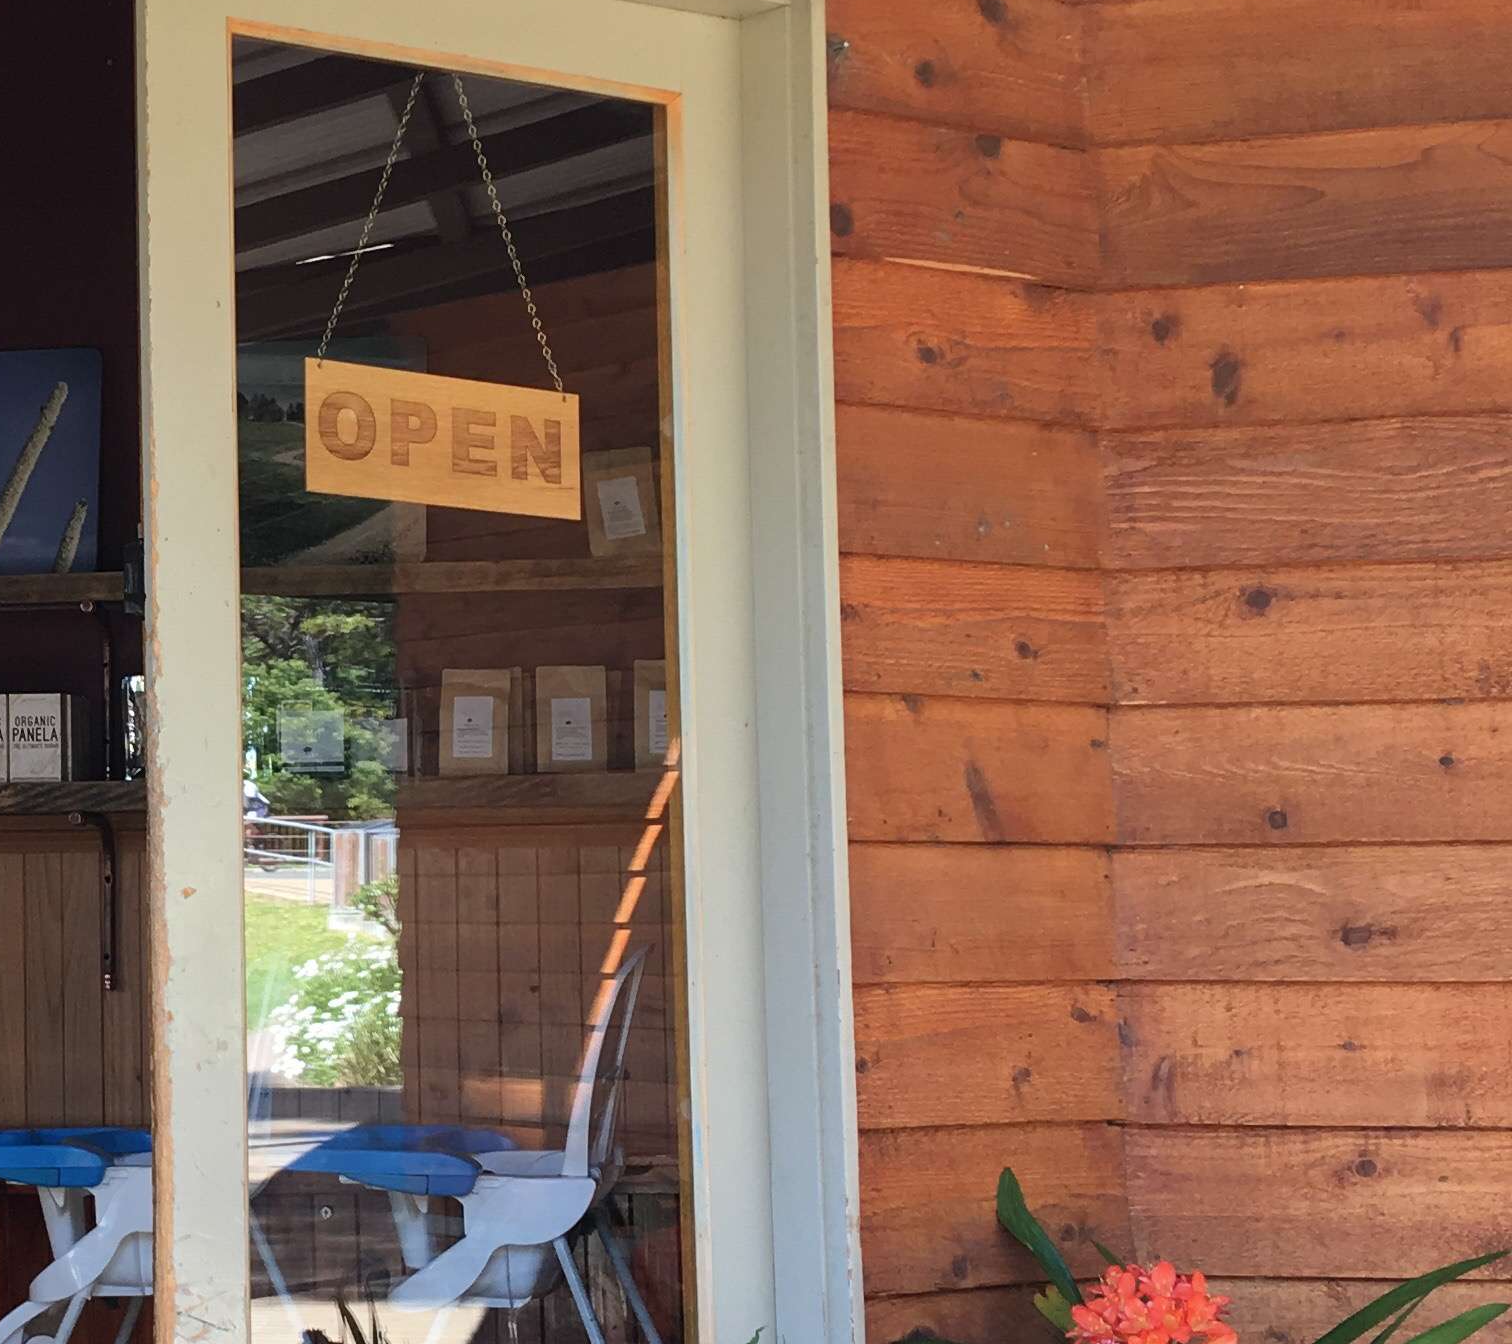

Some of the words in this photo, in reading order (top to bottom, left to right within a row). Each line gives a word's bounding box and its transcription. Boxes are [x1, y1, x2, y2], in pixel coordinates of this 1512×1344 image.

[317, 390, 563, 485] OPEN
[14, 715, 56, 727] ORGANIC
[12, 727, 59, 742] PANELA
